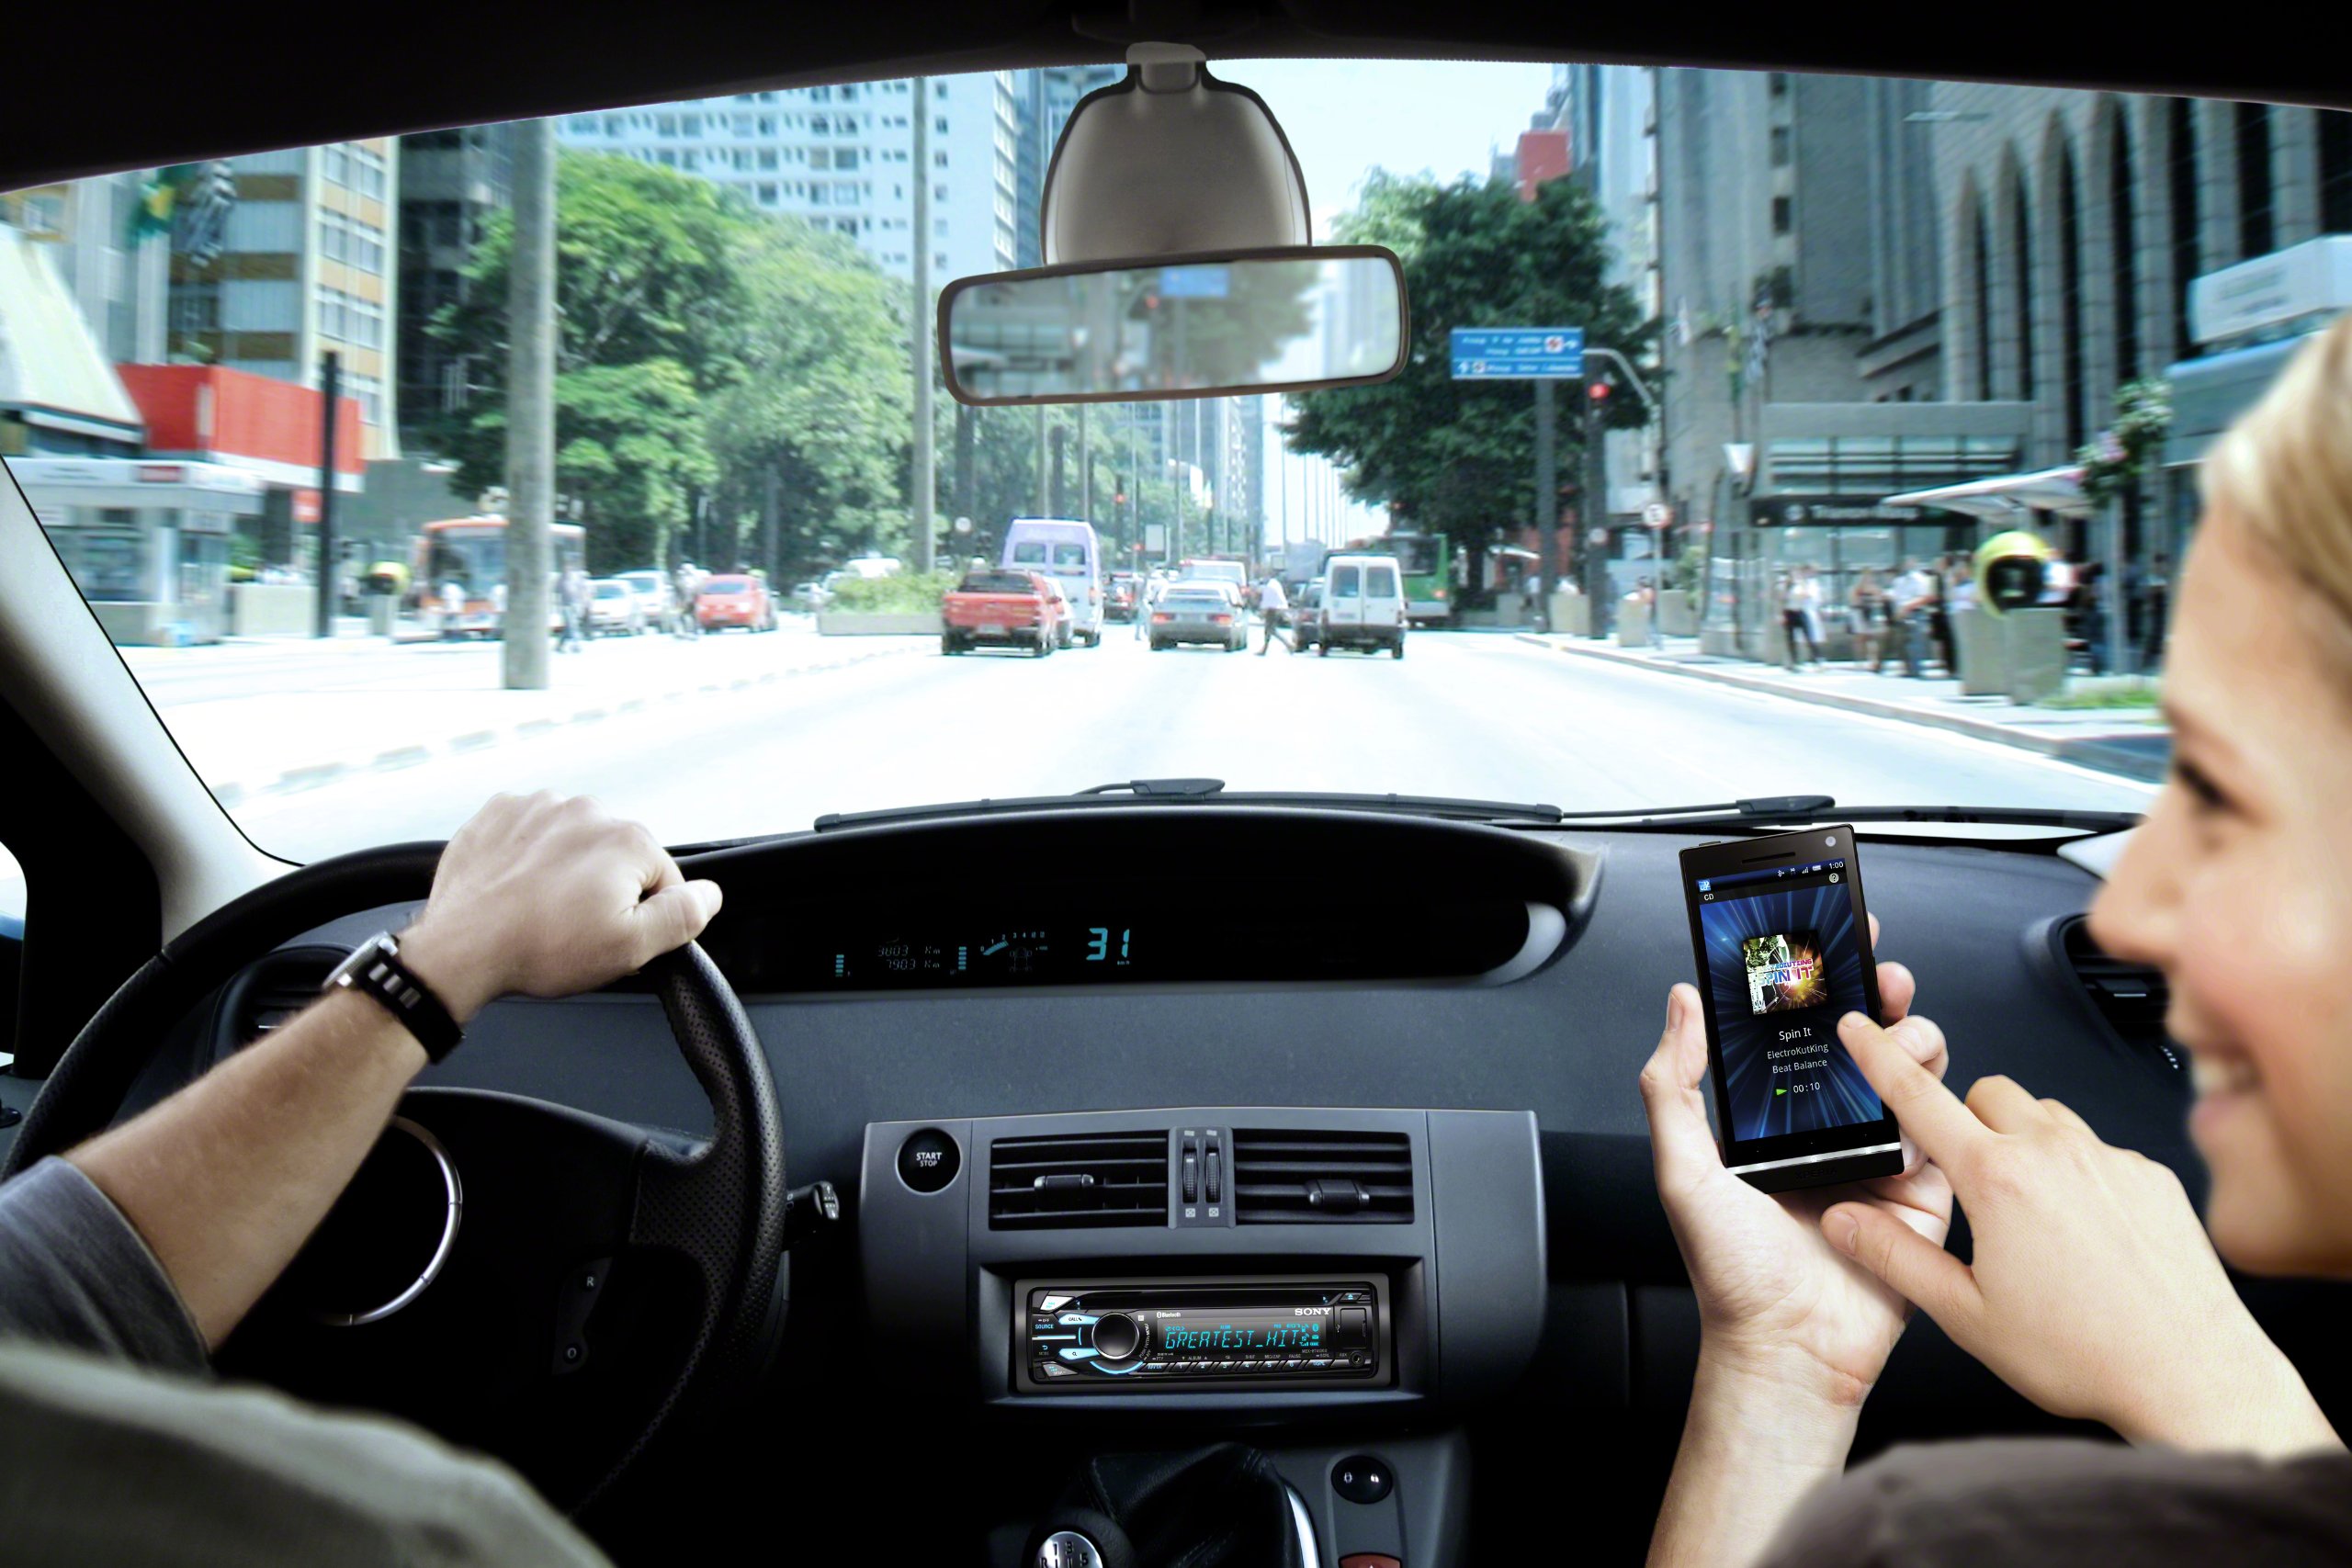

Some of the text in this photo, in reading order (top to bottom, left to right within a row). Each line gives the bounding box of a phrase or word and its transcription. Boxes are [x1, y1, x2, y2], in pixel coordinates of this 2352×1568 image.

[1828, 862, 1844, 870] 1:00
[1703, 893, 1714, 901] CD
[1086, 927, 1130, 960] 31
[1779, 1027, 1812, 1042] Spin It
[1767, 1043, 1829, 1059] ElectroKutKing
[1772, 1059, 1827, 1074] Beat Balance
[1793, 1081, 1821, 1093] 00:10
[916, 1152, 942, 1161] START
[586, 1276, 594, 1287] R
[1295, 1307, 1331, 1316] SONY
[1066, 1541, 1074, 1554] 3
